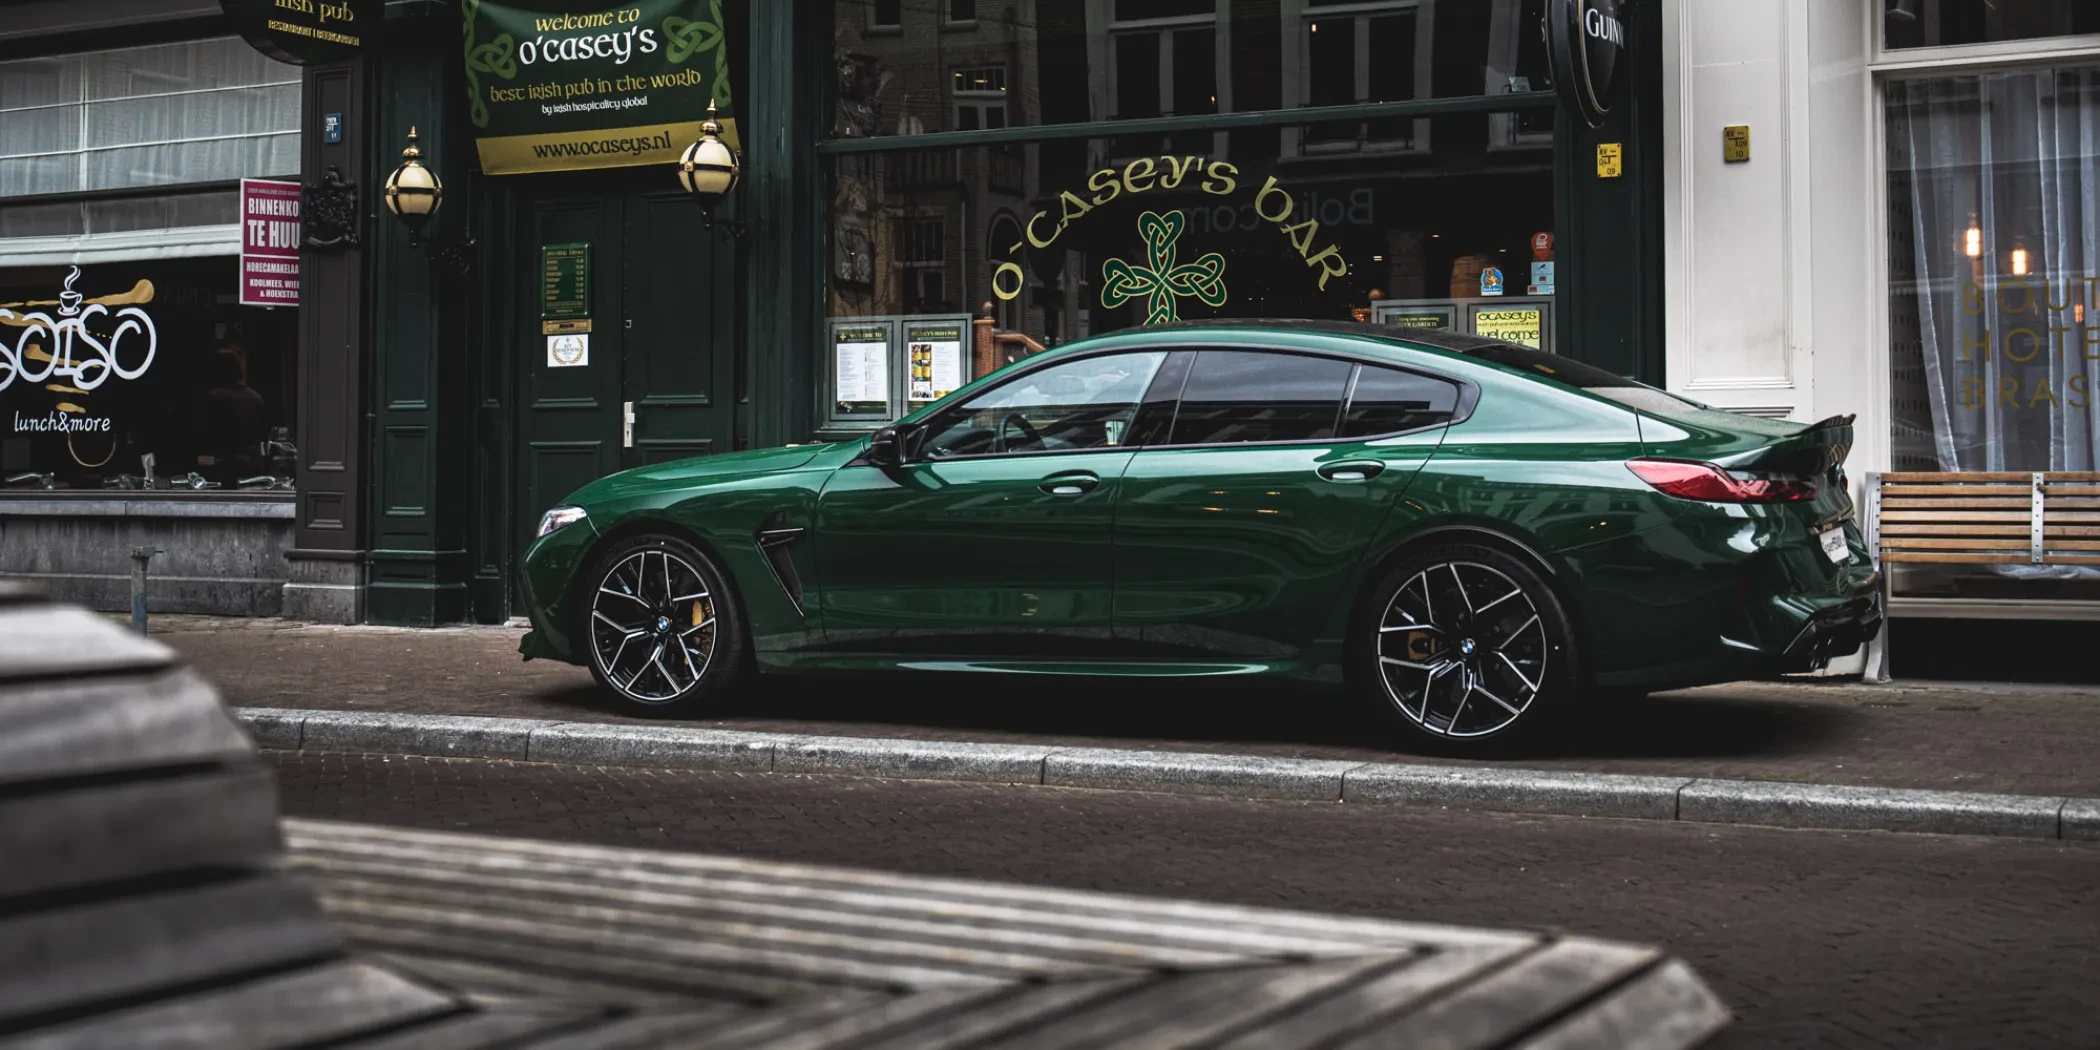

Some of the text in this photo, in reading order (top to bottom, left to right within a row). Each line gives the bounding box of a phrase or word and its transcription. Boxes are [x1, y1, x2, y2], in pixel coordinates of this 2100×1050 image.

[320, 2, 354, 23] pub
[535, 8, 640, 32] welcome to
[490, 68, 701, 101] best irish pub in the world
[541, 96, 648, 115] by irish hospitality global
[532, 131, 671, 158] www.ocaseys.nl
[248, 198, 299, 217] BINNENKO
[248, 220, 266, 247] TE
[266, 290, 299, 298] HOEKSTRA
[1963, 276, 2100, 316] BOUT
[1963, 326, 2100, 363] HOTE
[1964, 374, 2090, 409] BRAS
[14, 411, 110, 434] lunch&more
